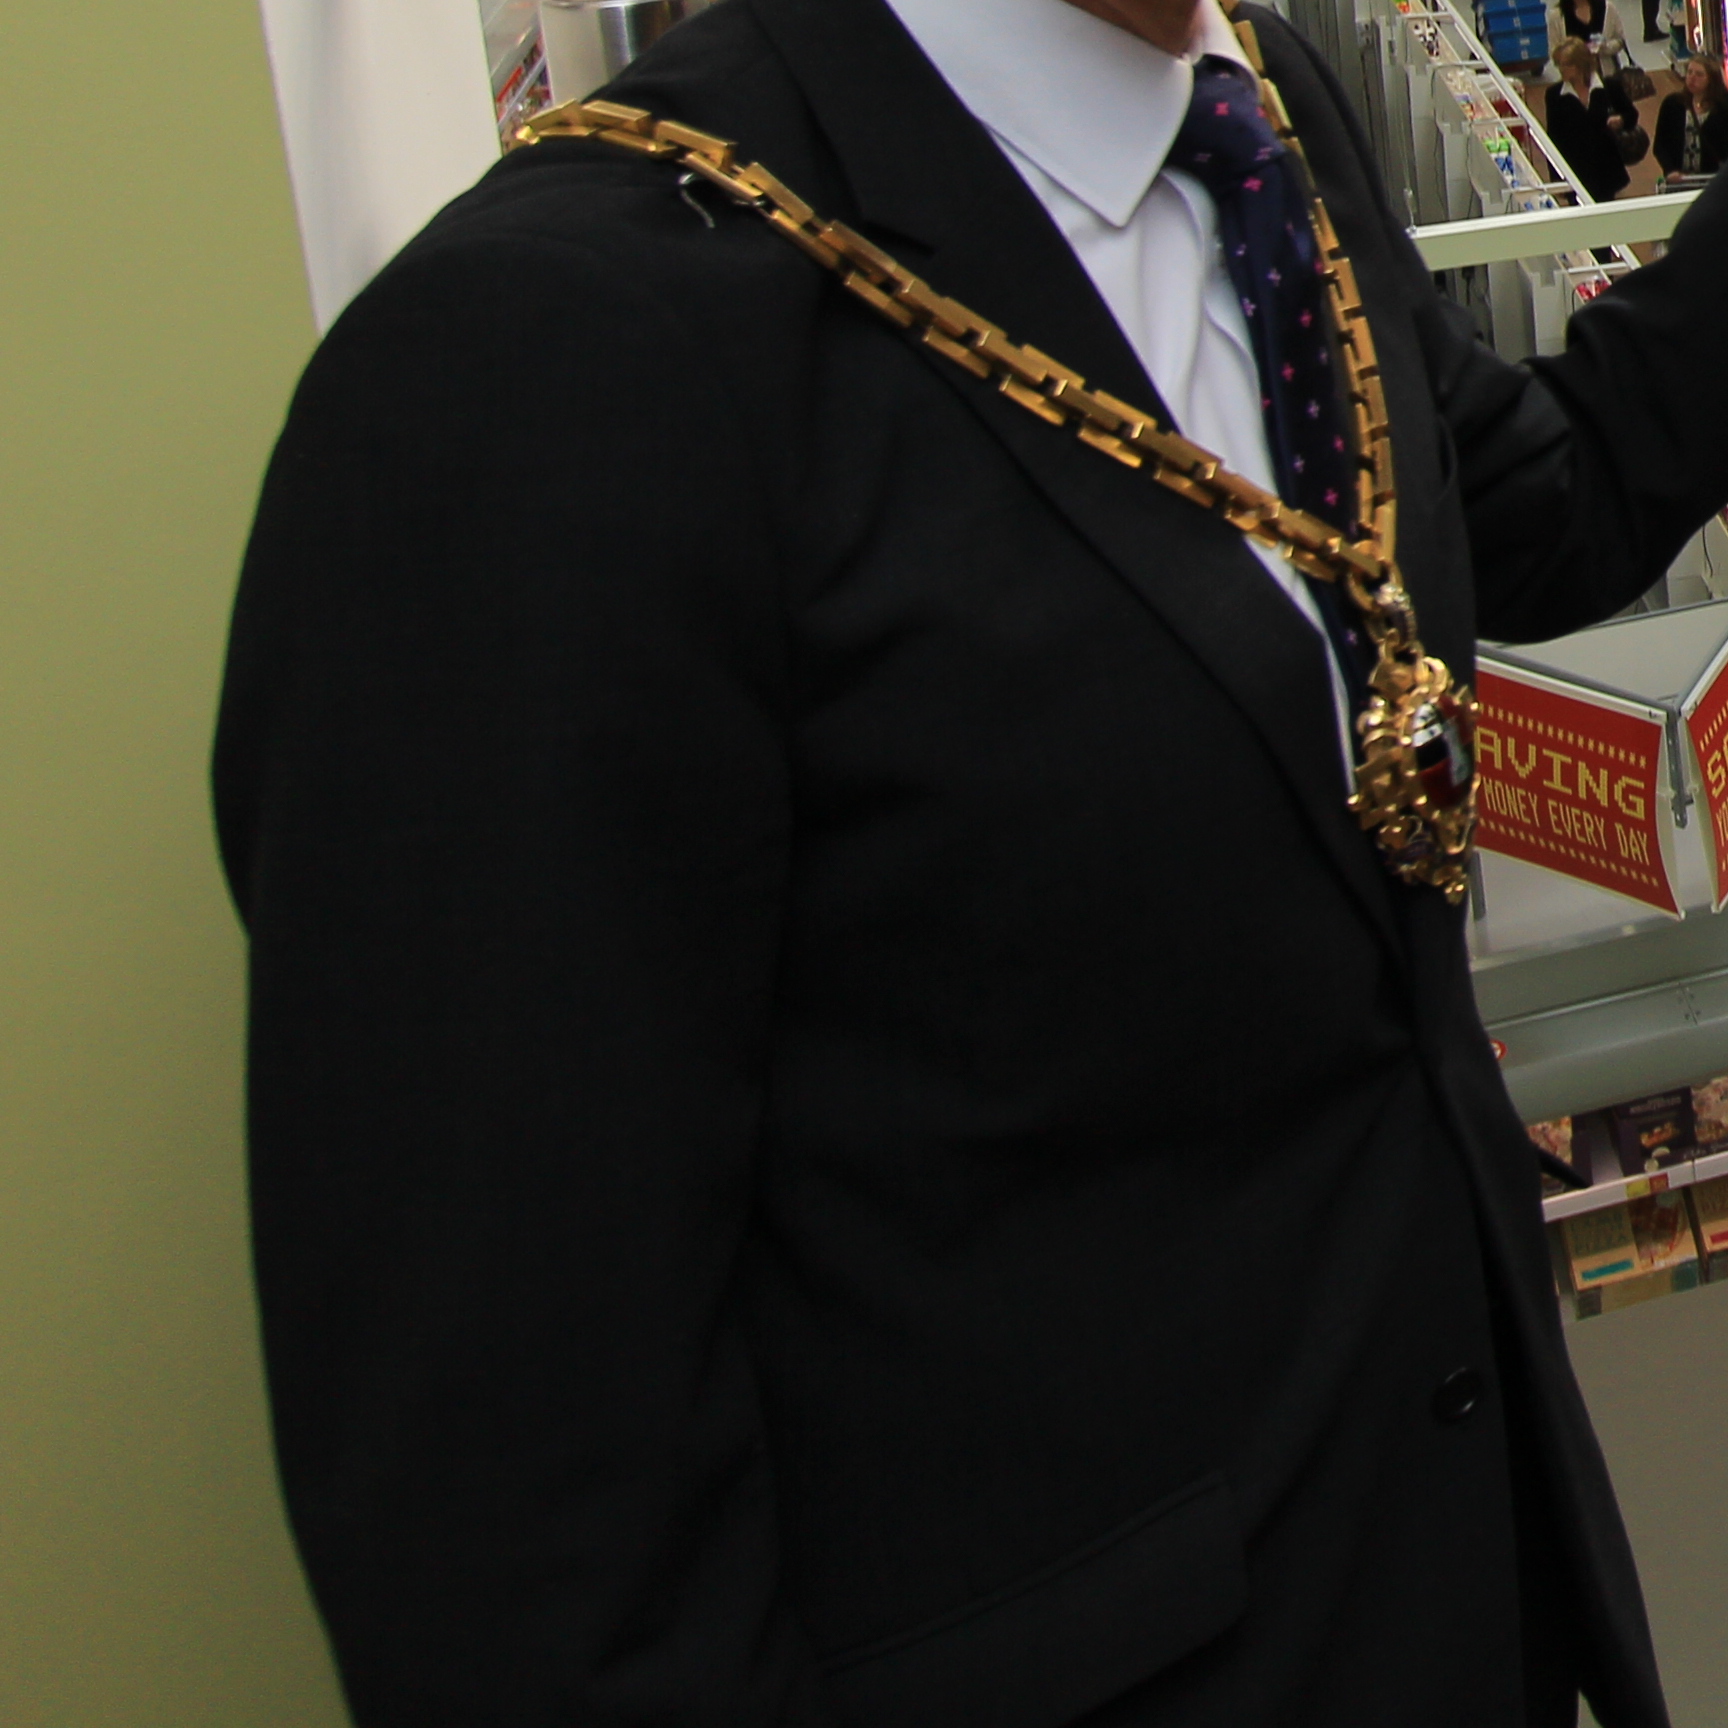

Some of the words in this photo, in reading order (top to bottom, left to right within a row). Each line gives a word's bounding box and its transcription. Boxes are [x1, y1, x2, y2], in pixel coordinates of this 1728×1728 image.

[1474, 725, 1646, 821] AVING
[1482, 775, 1541, 829] MONEY
[1547, 798, 1607, 852] EVERY
[1614, 821, 1650, 867] DAY
